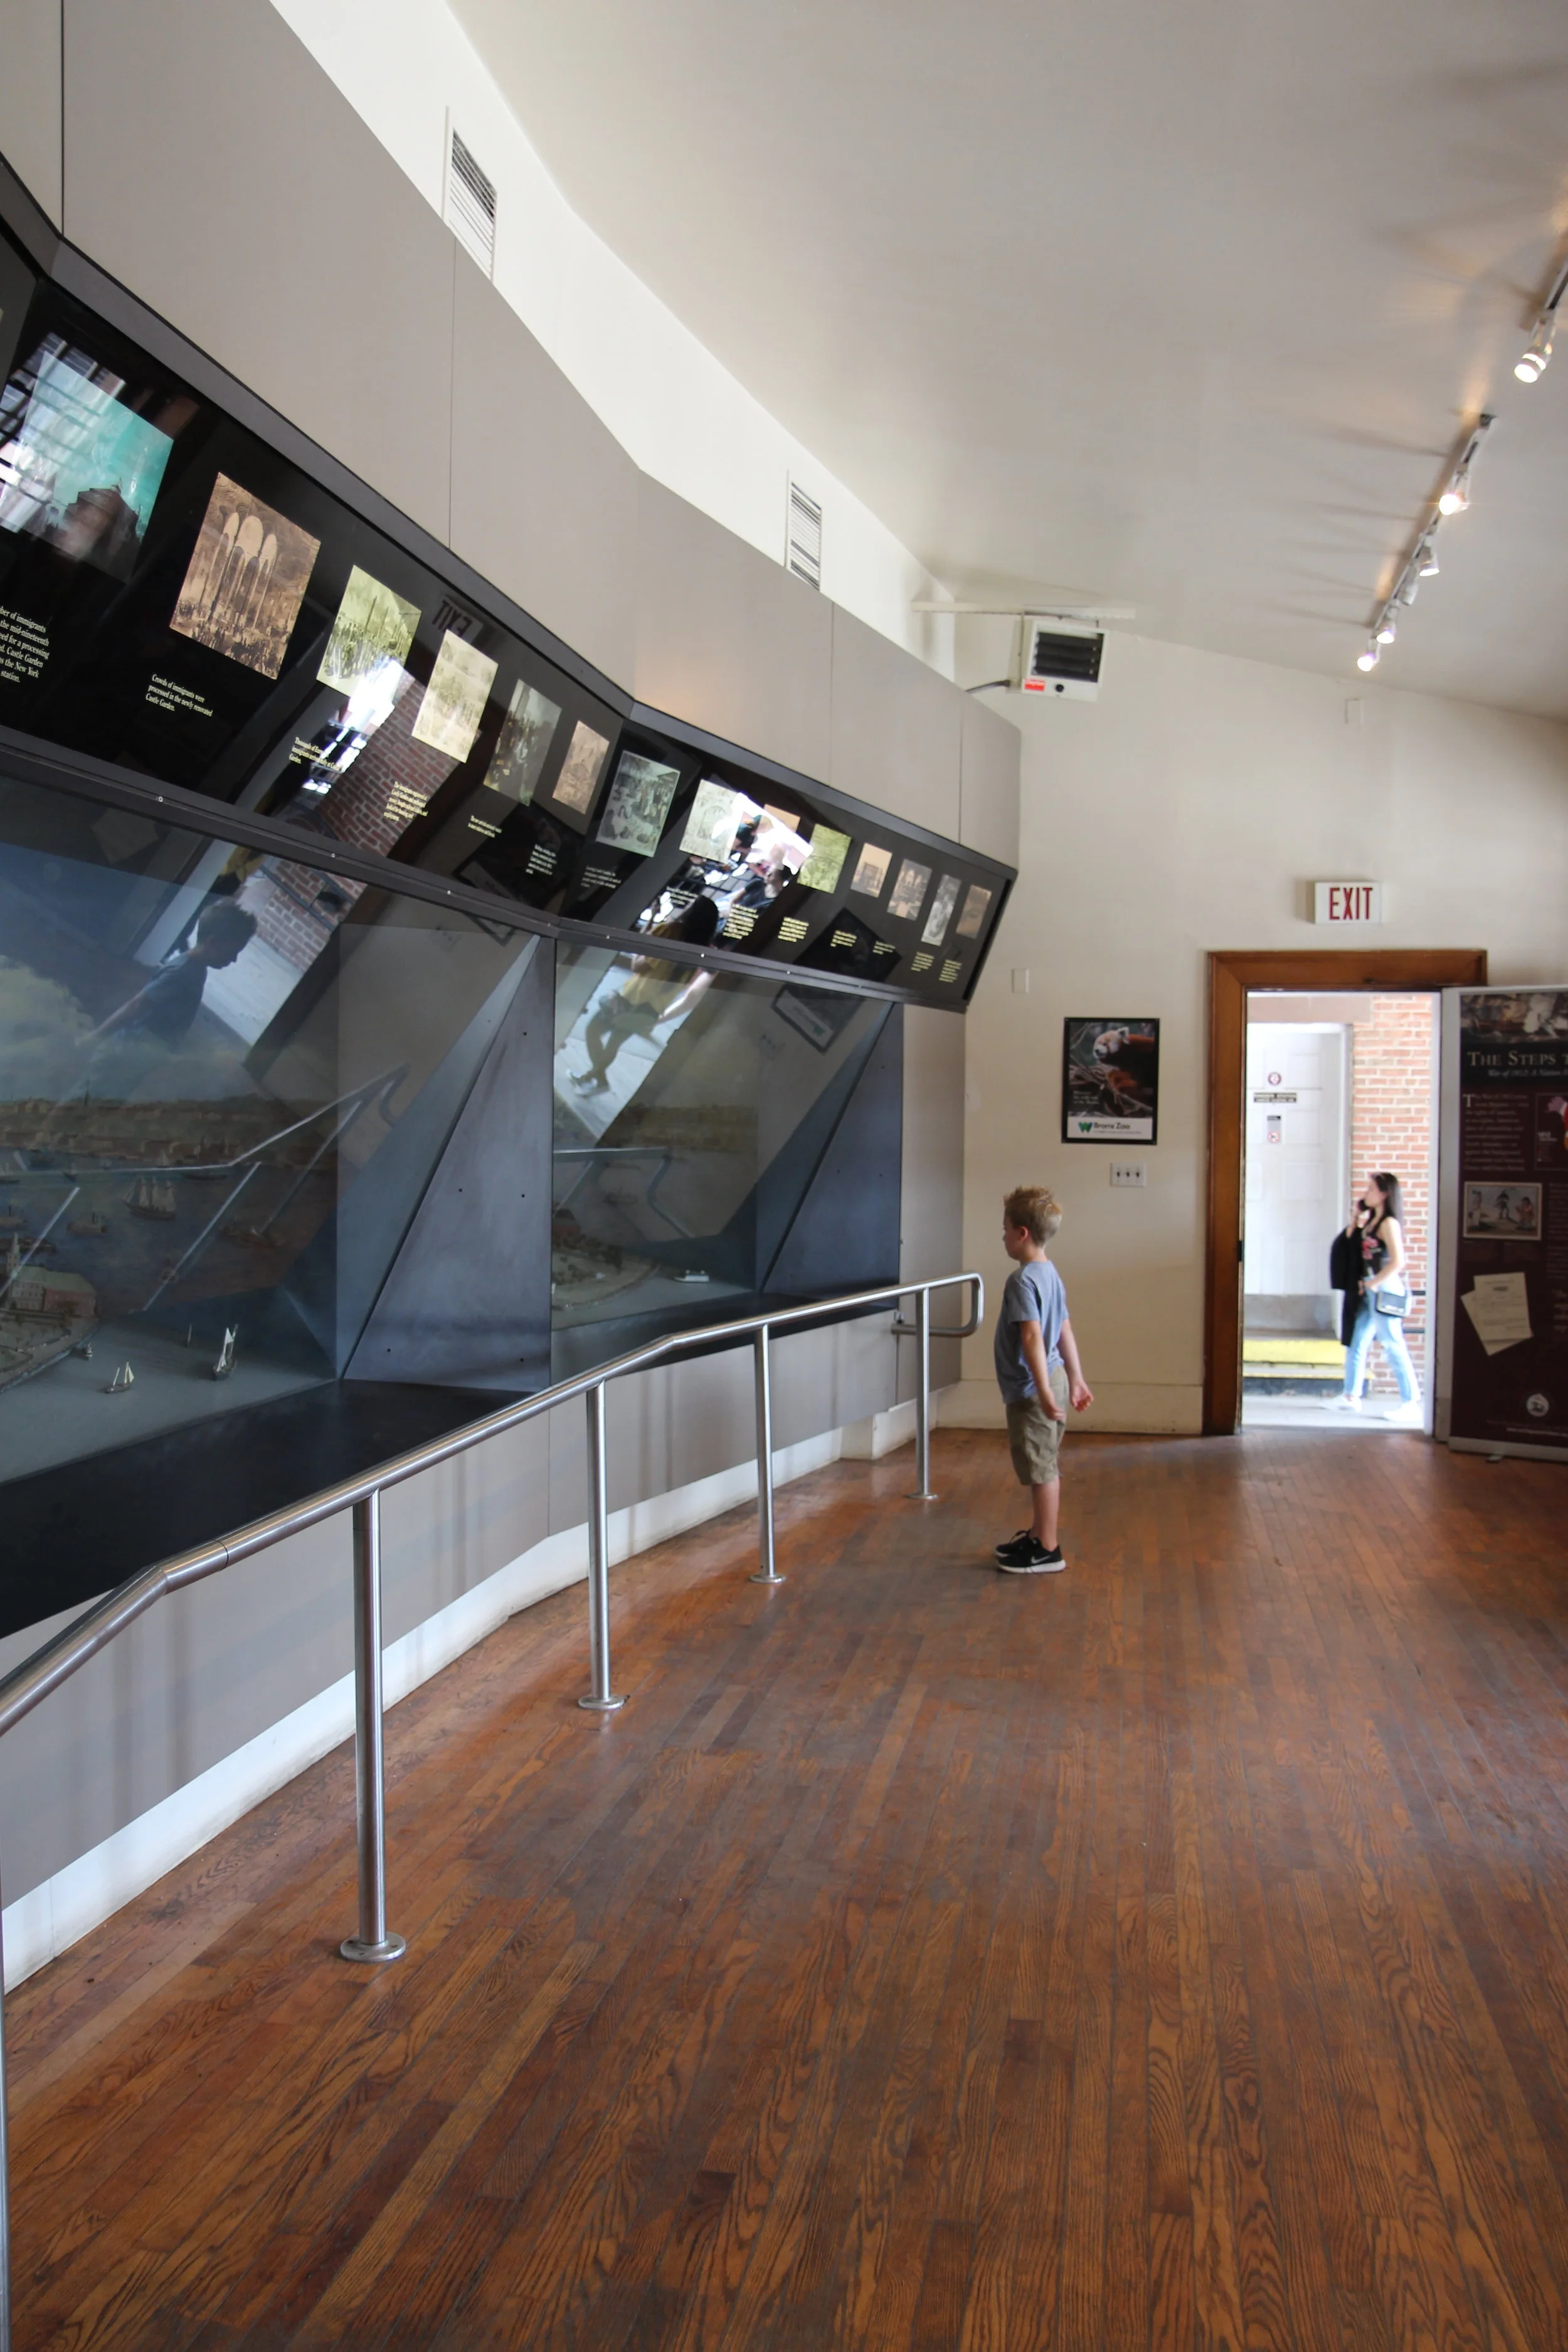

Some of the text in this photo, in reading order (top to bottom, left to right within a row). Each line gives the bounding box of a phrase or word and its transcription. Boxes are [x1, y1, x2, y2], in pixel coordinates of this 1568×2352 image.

[0, 606, 10, 617] ber
[16, 613, 46, 633] immigrants
[0, 620, 50, 647] the mid-nineteenth
[7, 646, 24, 660] Castle
[24, 654, 44, 668] Garden
[9, 635, 17, 645] for
[21, 642, 50, 660] processing
[1, 670, 21, 683] station.
[5, 659, 14, 668] the
[14, 661, 27, 673] New
[28, 666, 40, 679] York
[146, 693, 159, 704] Castle
[148, 685, 170, 698] processed
[152, 674, 167, 687] Crowds
[172, 682, 194, 699] immigrants
[195, 694, 205, 702] were
[1329, 886, 1374, 921] EXIT
